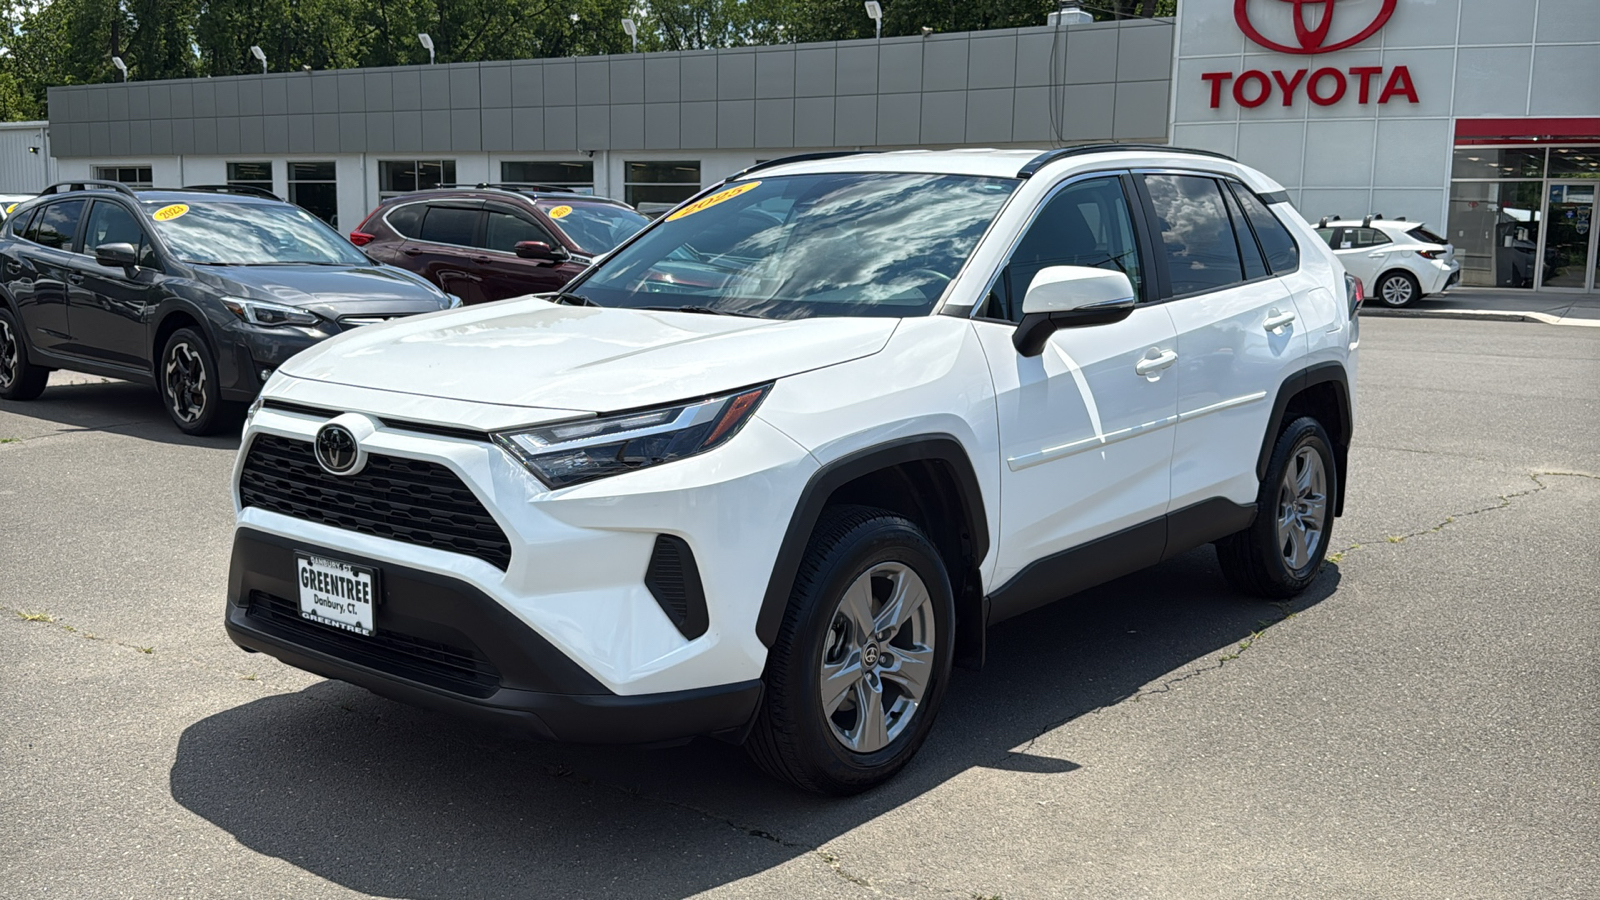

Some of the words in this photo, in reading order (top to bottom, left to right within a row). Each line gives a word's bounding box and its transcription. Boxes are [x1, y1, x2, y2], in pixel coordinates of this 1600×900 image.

[1201, 65, 1420, 109] TOYOTA
[159, 205, 184, 219] 2023
[301, 566, 369, 604] GREENTREE
[313, 593, 346, 614] Danbury,
[347, 602, 358, 615] CT.
[301, 612, 370, 636] GREENTREE
